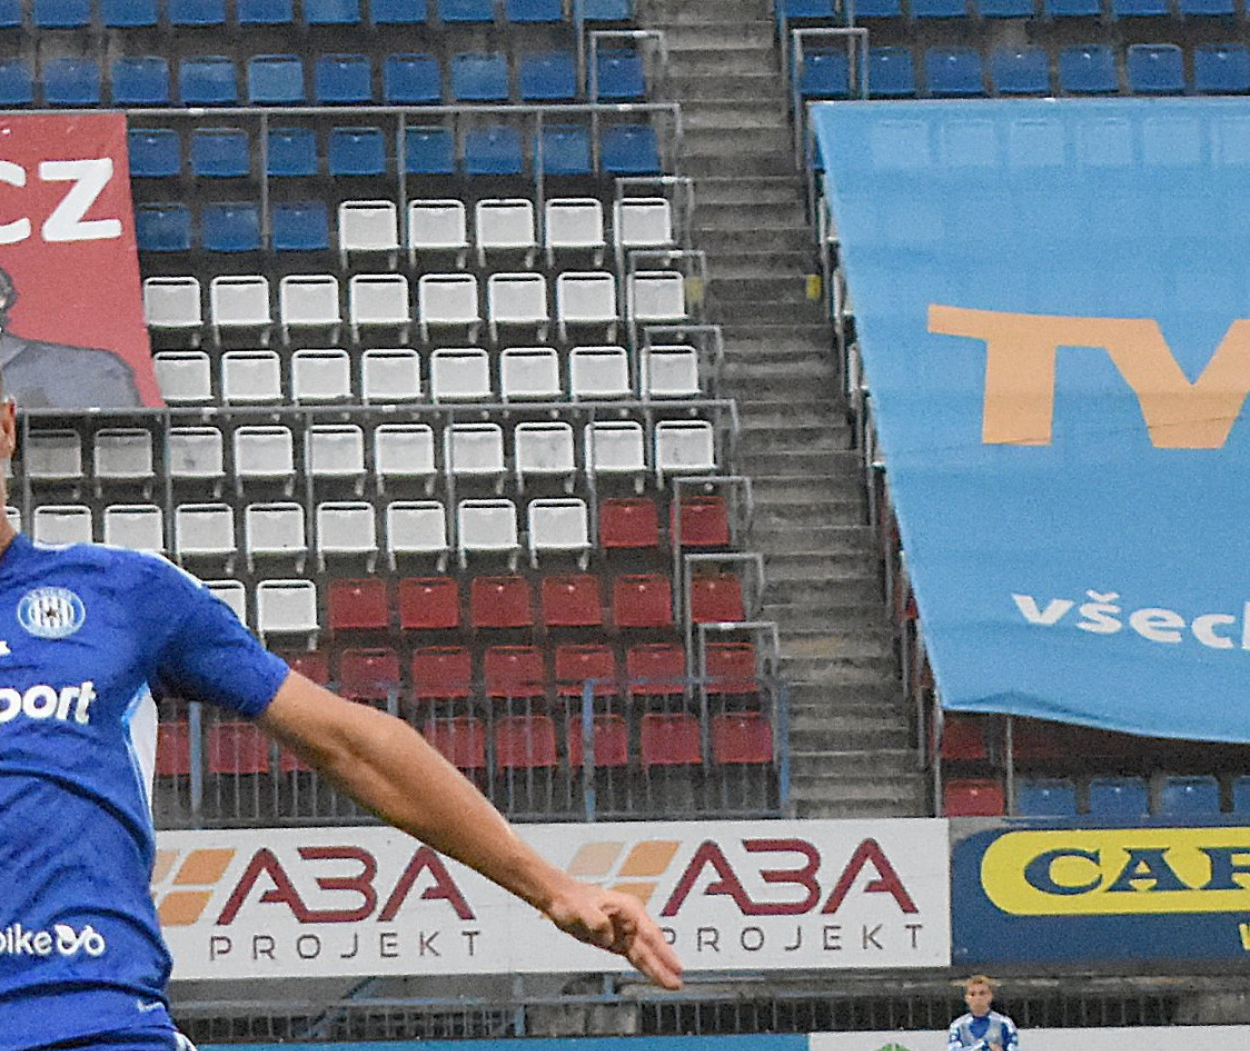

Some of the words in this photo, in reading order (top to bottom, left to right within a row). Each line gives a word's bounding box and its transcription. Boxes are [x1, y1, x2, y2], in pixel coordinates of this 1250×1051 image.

[1012, 590, 1250, 651] všec
[215, 846, 476, 926] ABA
[661, 837, 920, 917] ABA
[210, 931, 481, 961] PROJEKT
